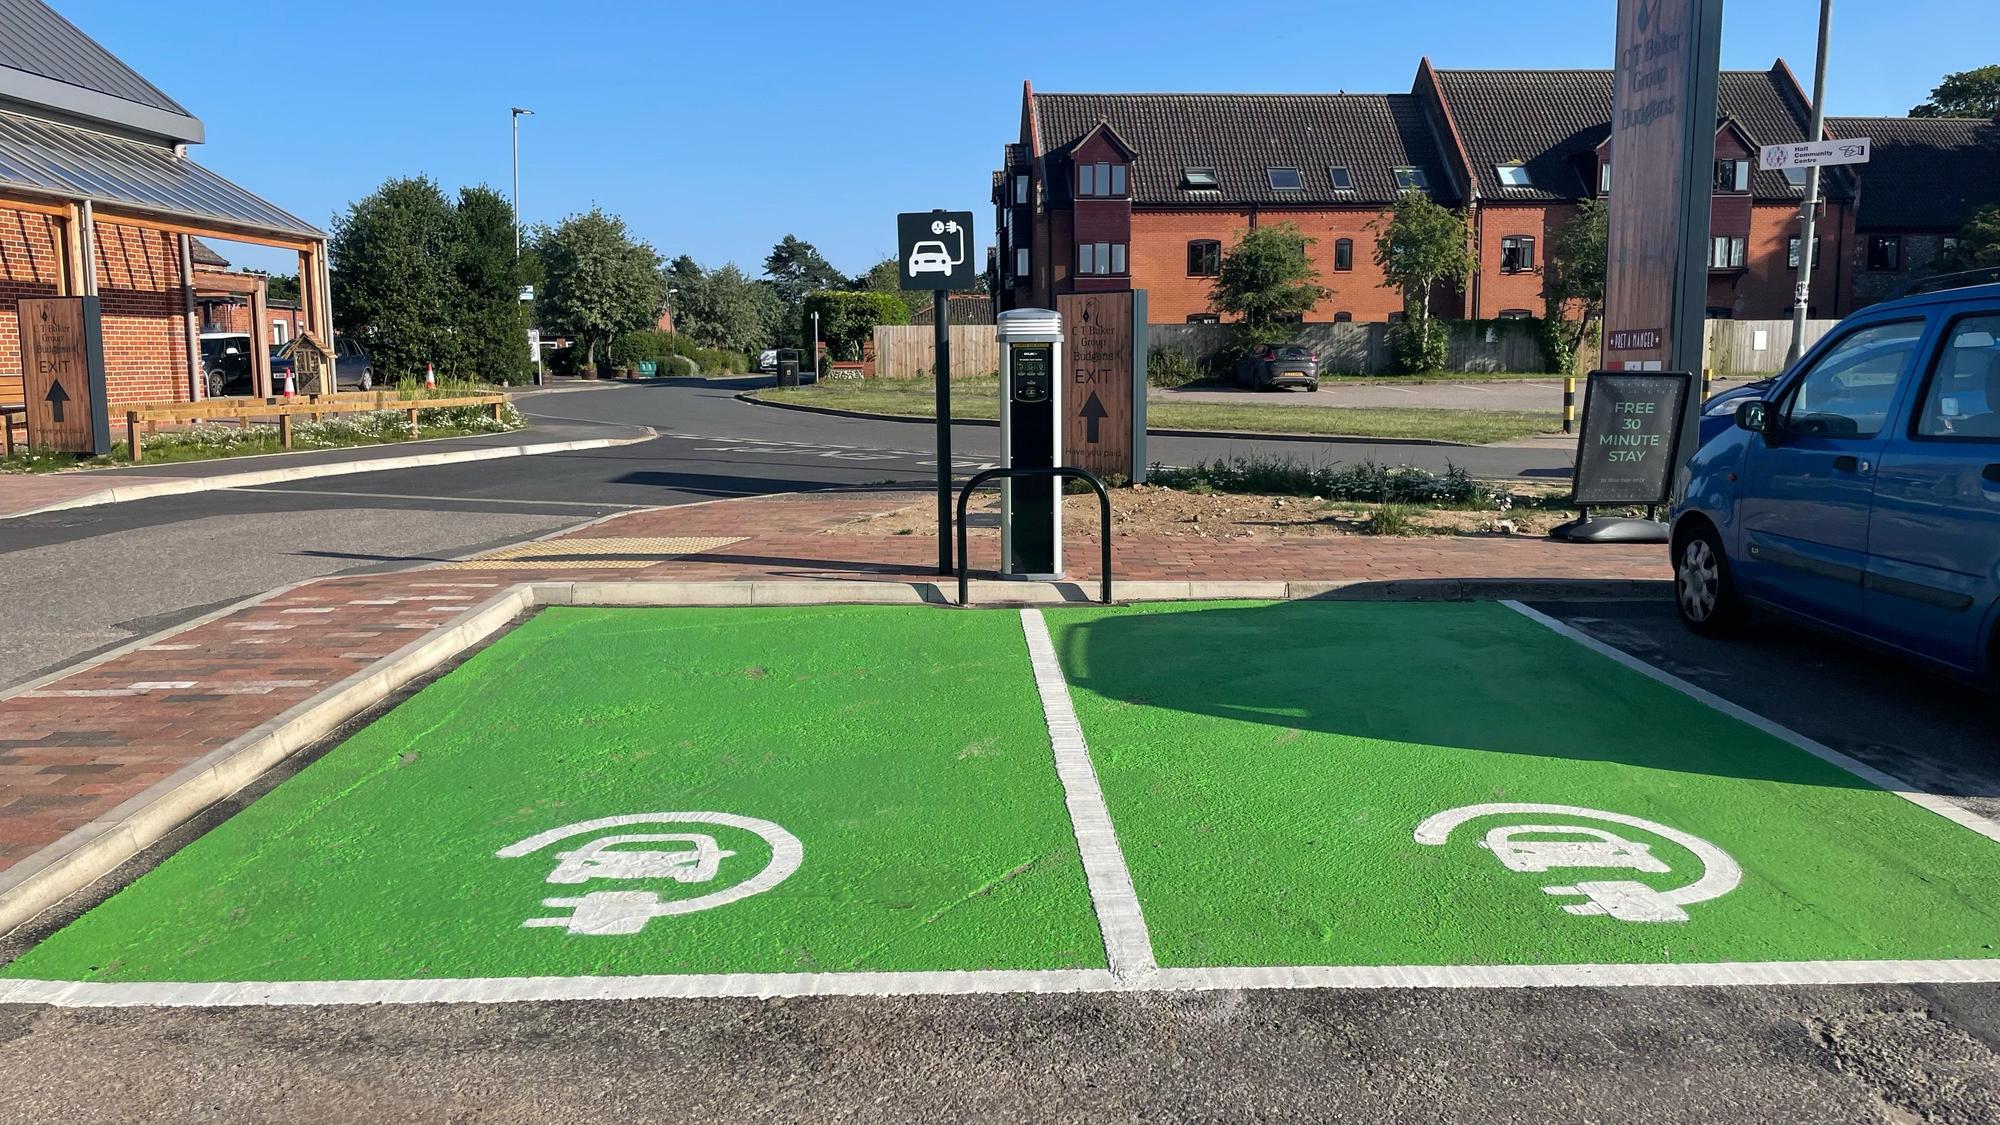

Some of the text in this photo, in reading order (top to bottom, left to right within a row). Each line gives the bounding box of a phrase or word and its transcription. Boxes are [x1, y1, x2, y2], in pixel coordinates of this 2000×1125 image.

[1633, 66, 1667, 92] Group
[1621, 96, 1676, 130] Budgens
[1794, 150, 1833, 158] Community
[1080, 326, 1086, 335] T
[1089, 325, 1115, 336] Baker
[1081, 337, 1107, 348] Group
[1614, 331, 1654, 349] PRET A MANGER
[1073, 351, 1114, 362] Budgens
[40, 360, 71, 374] EXIT
[1075, 368, 1112, 385] EXIT
[1615, 402, 1656, 414] FREE
[1622, 418, 1642, 430] 30
[1599, 434, 1661, 446] MINUTE
[1065, 447, 1085, 456] Have
[1086, 449, 1102, 457] you
[1608, 450, 1646, 462] STAY
